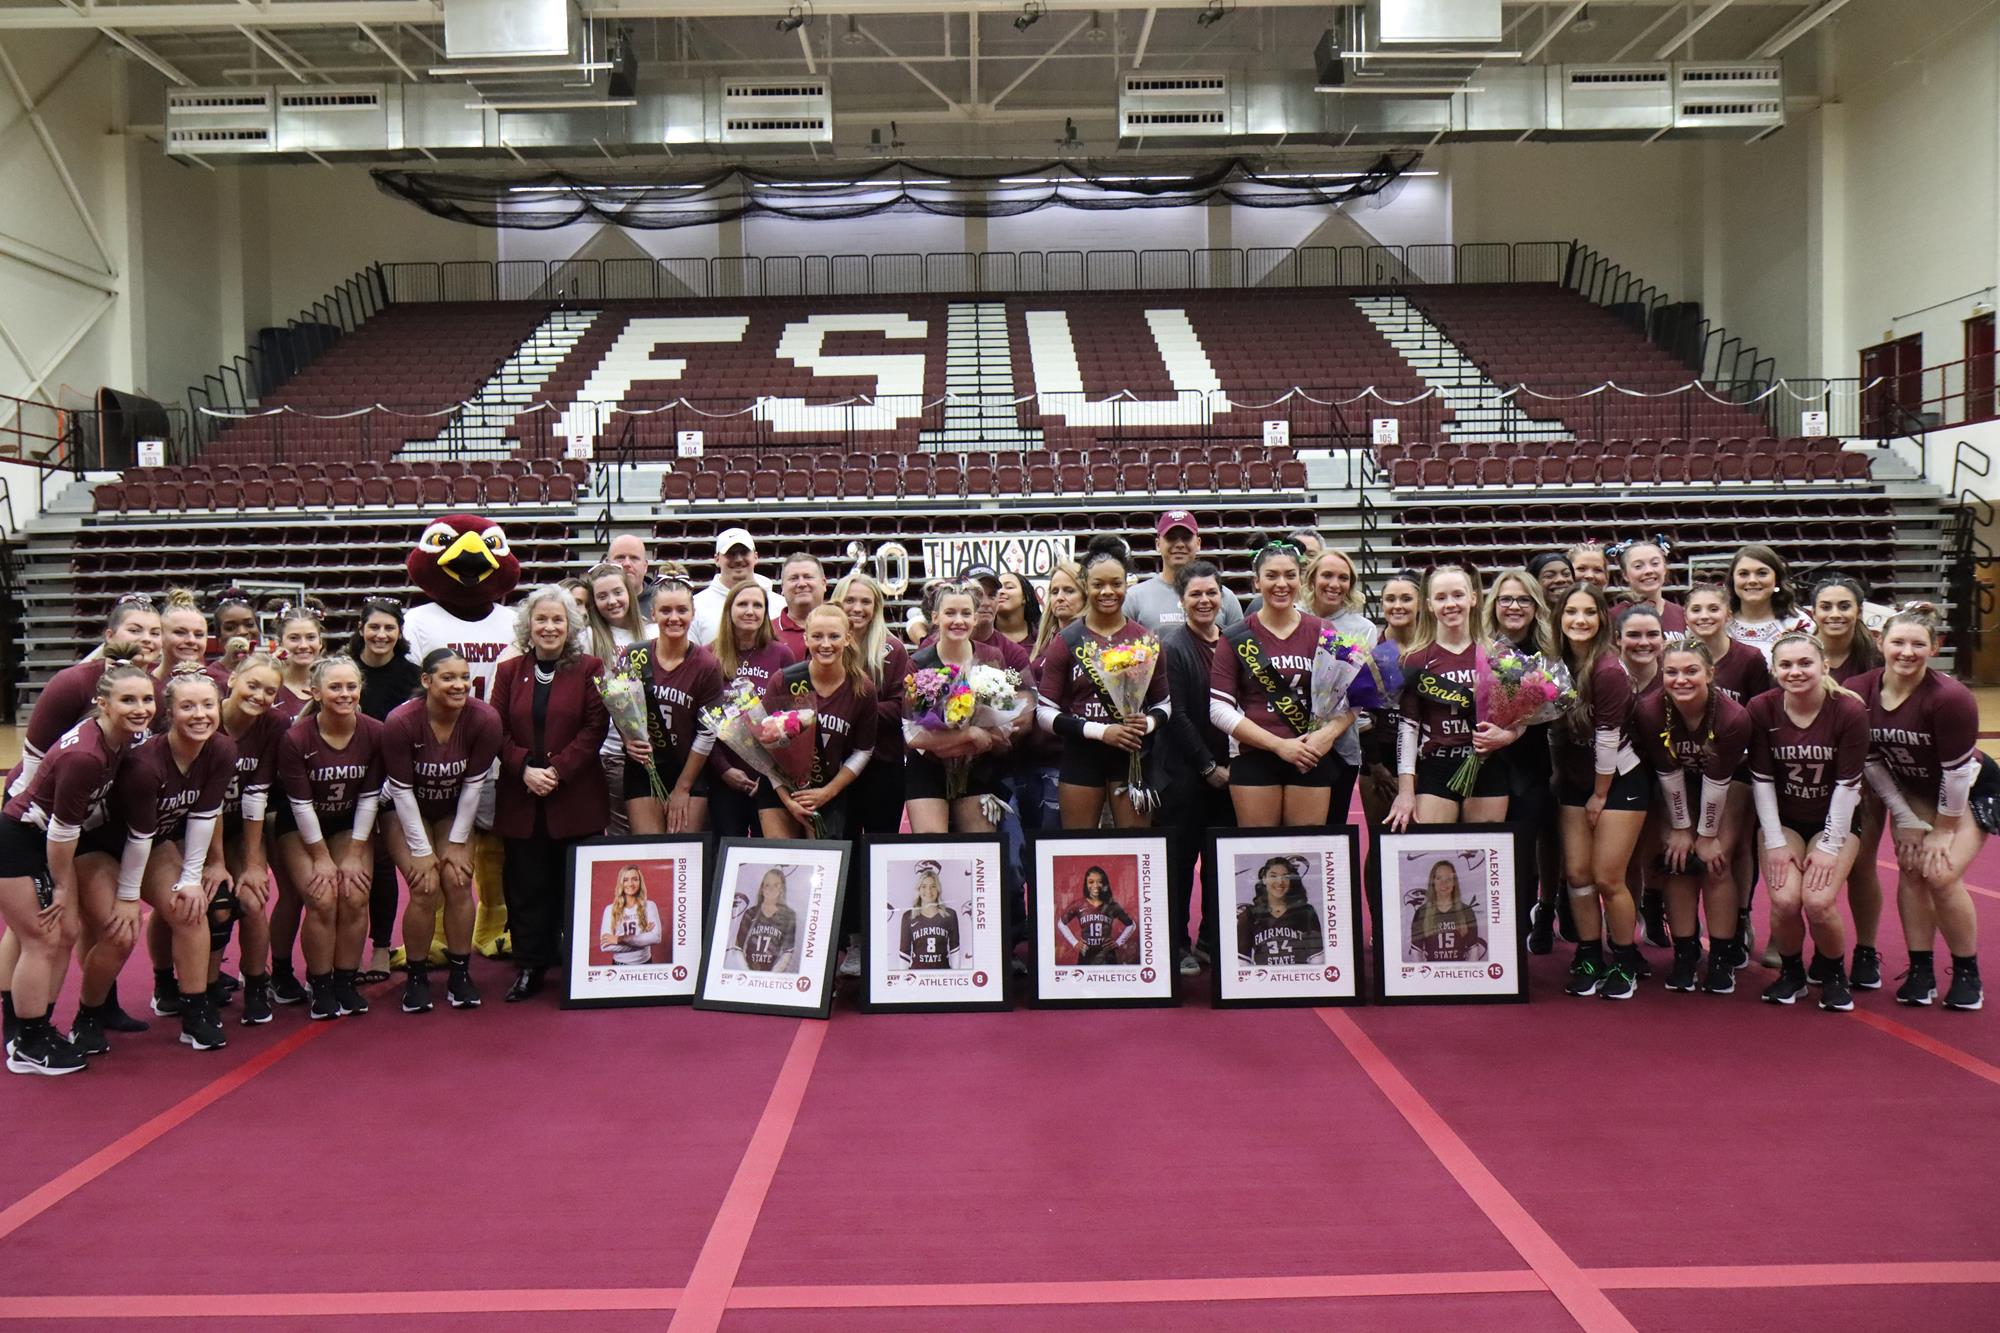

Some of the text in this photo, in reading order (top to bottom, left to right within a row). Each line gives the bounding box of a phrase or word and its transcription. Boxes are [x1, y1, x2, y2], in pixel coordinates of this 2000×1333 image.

[552, 309, 1232, 437] FSU
[1270, 436, 1283, 445] 104
[1379, 434, 1393, 443] 105
[574, 449, 587, 458] 103
[684, 447, 698, 455] 104
[924, 539, 1011, 577] THANK
[447, 643, 508, 663] AIRMON
[1238, 638, 1277, 693] Senior
[1270, 655, 1314, 671] RMON
[736, 664, 769, 679] obatics
[653, 685, 694, 709] MONT
[1417, 673, 1471, 708] Senior
[1085, 702, 1109, 718] STA
[817, 712, 851, 736] MONT
[1442, 719, 1470, 735] STA
[1869, 727, 1932, 746] IRMONT
[1772, 744, 1837, 761] AIRMON
[309, 764, 369, 782] AIRMON
[414, 759, 470, 777] AIRMON
[1785, 763, 1825, 784] 27
[327, 783, 346, 801] 3
[1784, 782, 1829, 799] STATE
[1705, 801, 1717, 829] FALCONS
[975, 858, 986, 930] ANNIE LEASE
[1488, 848, 1501, 925] ALEXIS SMITH
[677, 857, 687, 946] BRIONI DOWSON
[1325, 851, 1338, 948] HANNAH SADLER
[805, 864, 825, 958] ANLEY FROMAN
[1142, 853, 1153, 965] PRISCILLA RICHMOND
[1090, 922, 1103, 937] 19
[1255, 927, 1303, 946] FAIRMONT
[756, 935, 771, 952] 17
[926, 938, 936, 953] 8
[1267, 940, 1293, 954] 34
[1438, 932, 1455, 949] 15
[751, 953, 772, 963] STATE
[919, 954, 942, 962] STATE
[1267, 955, 1296, 966] STATE
[1433, 950, 1459, 959] STATE
[620, 972, 669, 981] ATHLETICS
[674, 968, 686, 978] 16
[976, 974, 984, 984] 8
[1087, 973, 1137, 982] ATHLETICS
[1142, 970, 1154, 980] 19
[1270, 973, 1321, 982] ATHLETICS
[1326, 969, 1339, 978] 34
[1434, 970, 1484, 979] ATHLETICS
[1489, 967, 1501, 975] 15
[748, 980, 793, 990] ATHLETICS
[798, 980, 810, 989] 17
[918, 978, 969, 986] ATHLETICS
